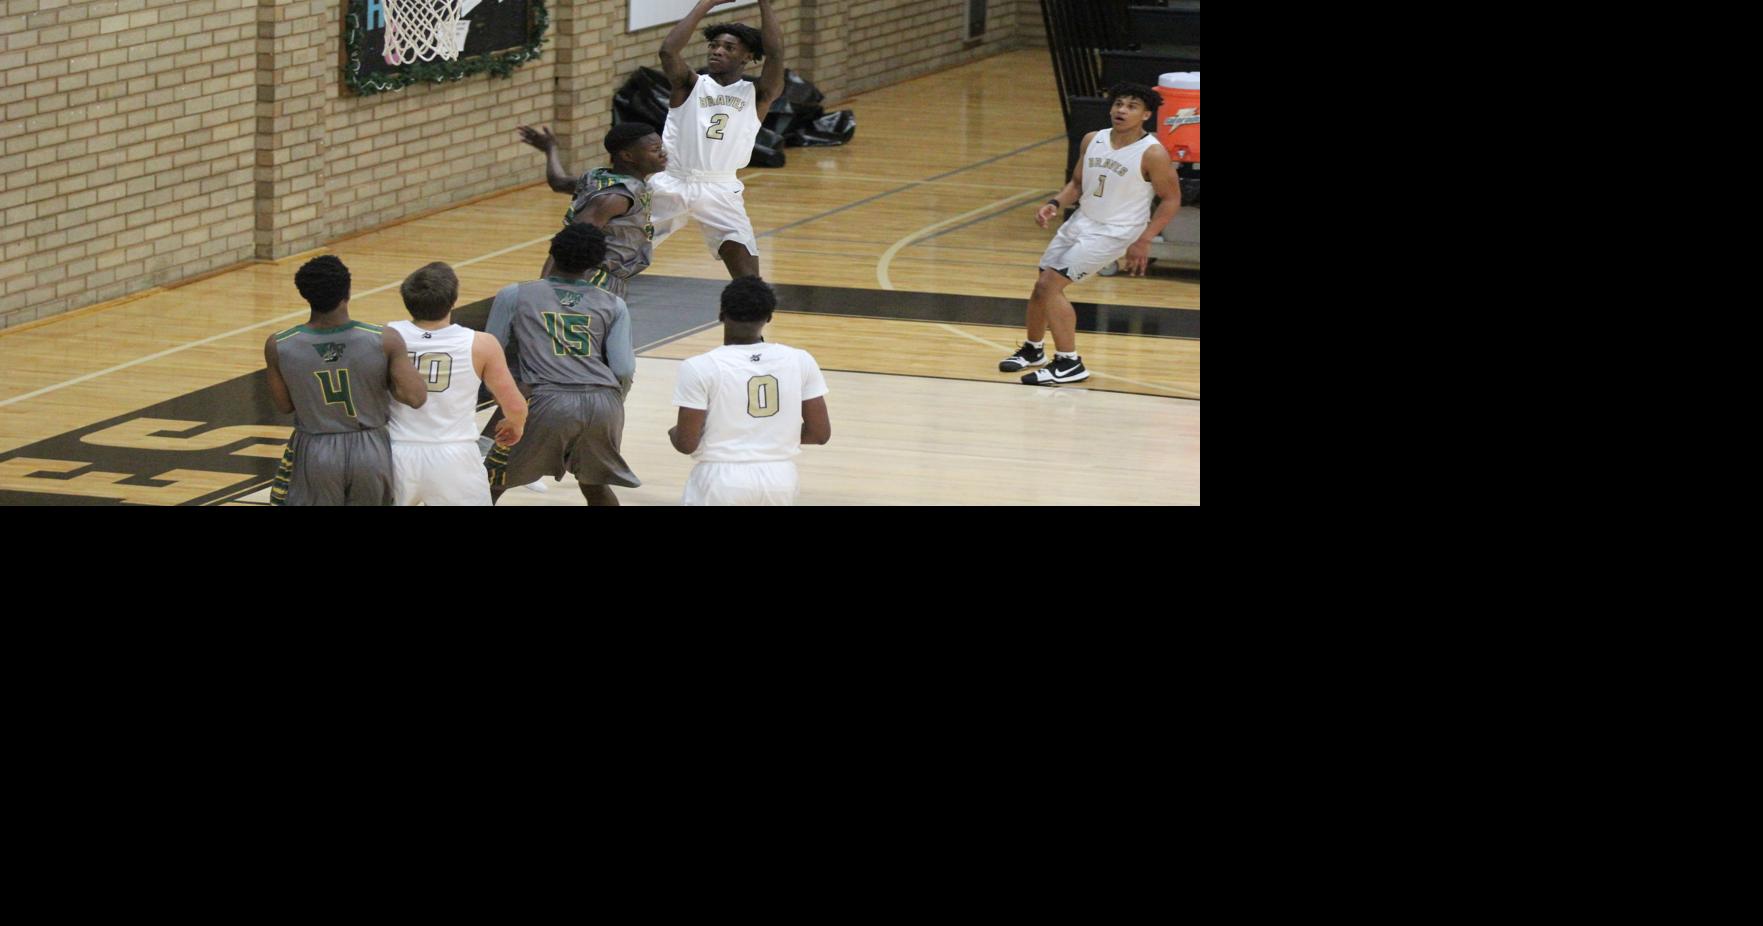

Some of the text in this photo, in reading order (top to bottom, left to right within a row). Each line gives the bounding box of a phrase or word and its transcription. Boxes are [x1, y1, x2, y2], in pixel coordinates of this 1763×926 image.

[706, 113, 729, 141] 2
[1093, 174, 1107, 198] 1
[541, 311, 592, 357] 15
[313, 368, 358, 418] 4
[407, 351, 453, 393] 0
[747, 374, 780, 419] 0
